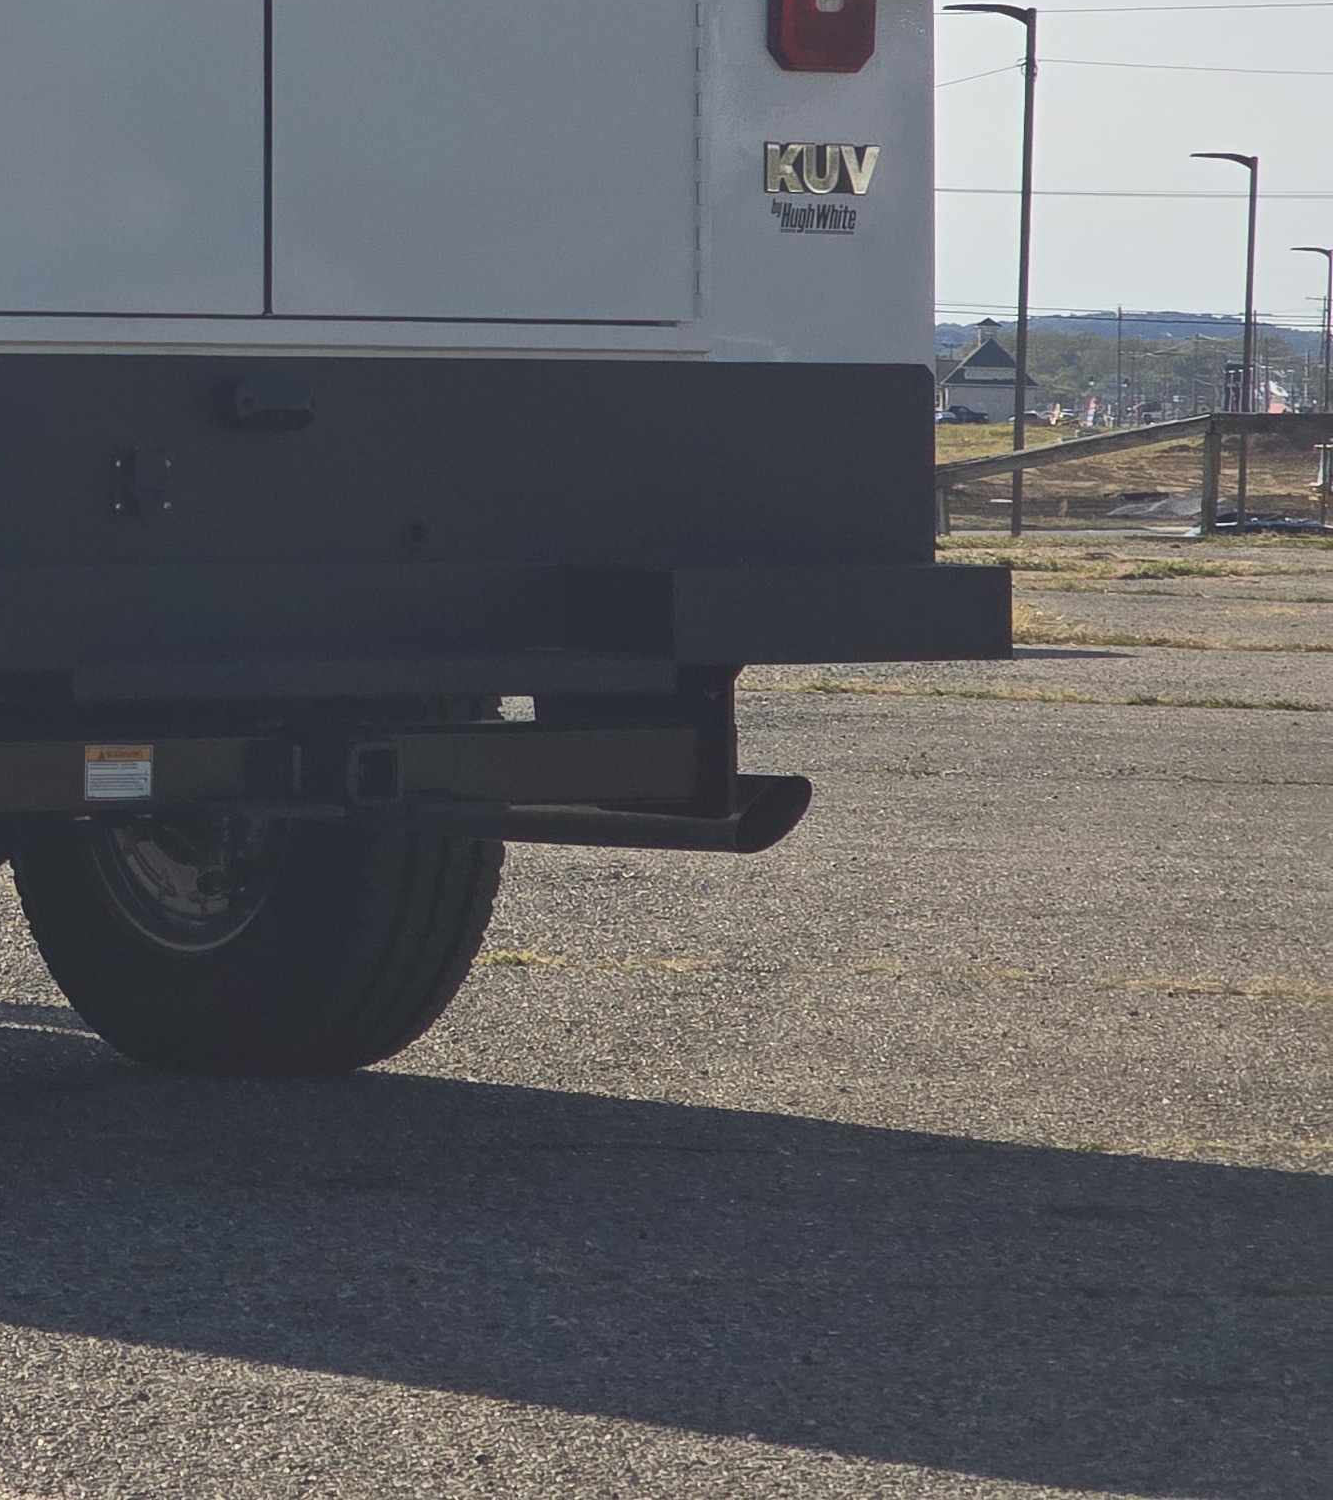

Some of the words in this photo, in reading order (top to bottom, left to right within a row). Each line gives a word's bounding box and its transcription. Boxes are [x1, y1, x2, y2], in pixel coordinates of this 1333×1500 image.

[764, 141, 881, 195] KUV
[781, 202, 815, 233] Hugh
[816, 204, 857, 230] White
